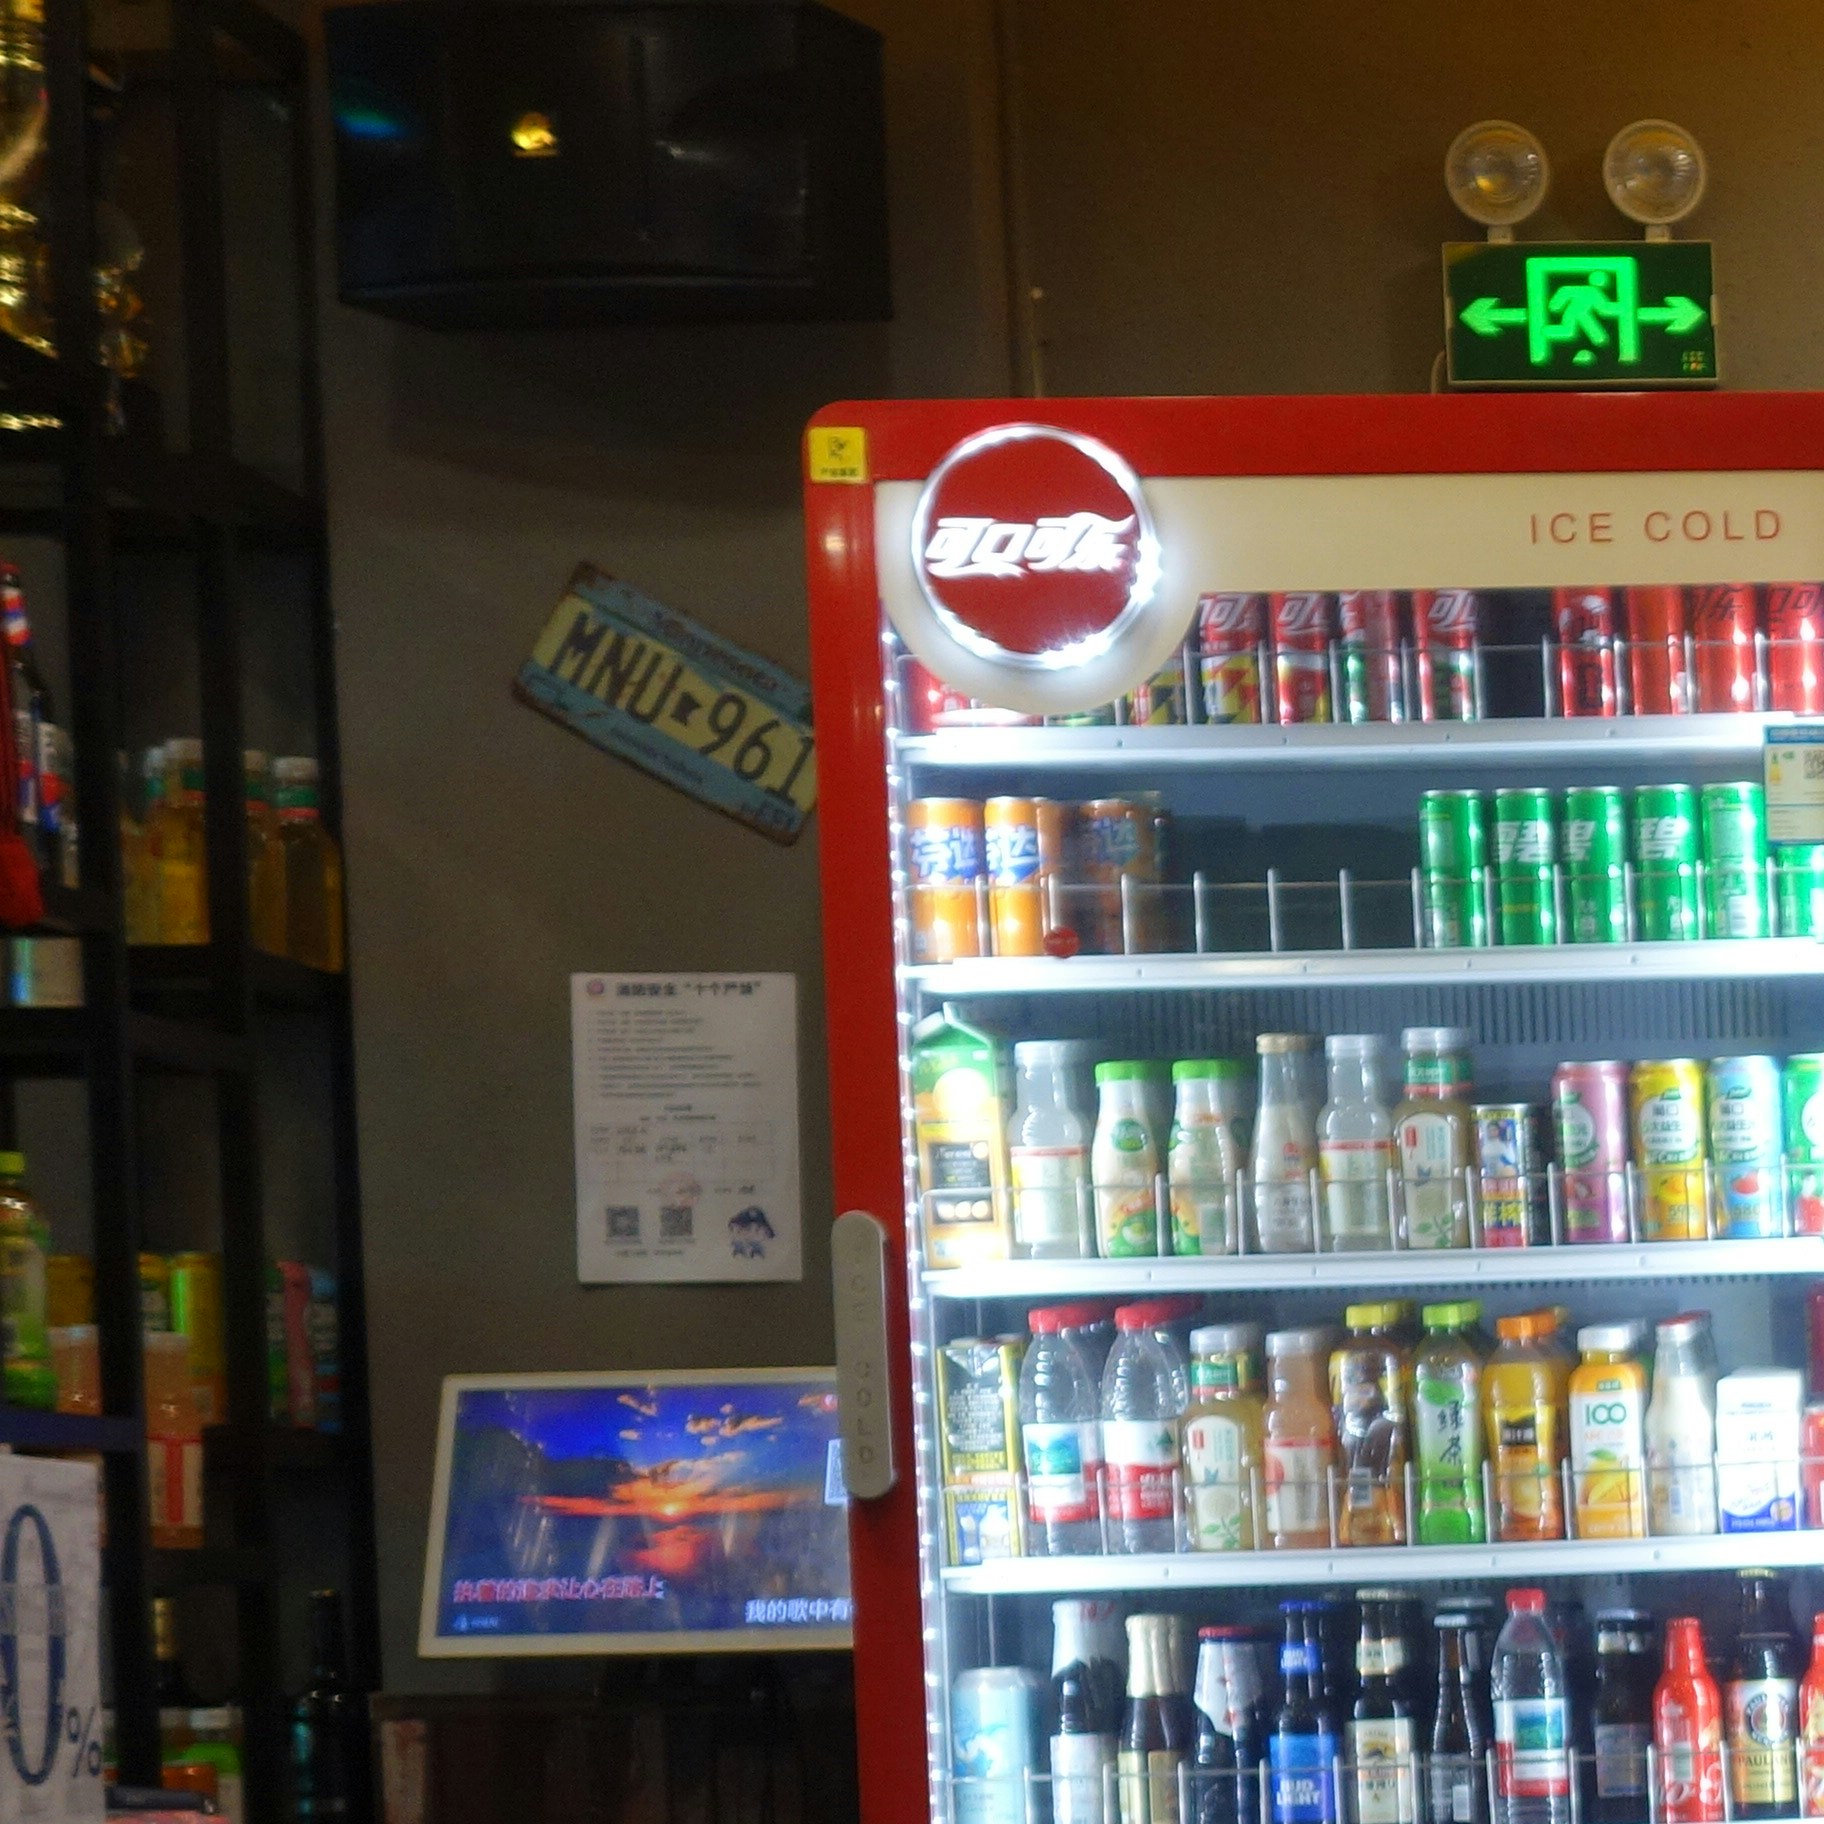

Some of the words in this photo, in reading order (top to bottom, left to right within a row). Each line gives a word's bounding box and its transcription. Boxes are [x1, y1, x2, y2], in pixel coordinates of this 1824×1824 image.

[1530, 511, 1613, 546] ICE
[1643, 509, 1782, 543] COLD
[549, 611, 683, 724] MNU
[1585, 1401, 1627, 1427] 100
[745, 1598, 853, 1624] 我的歌中有
